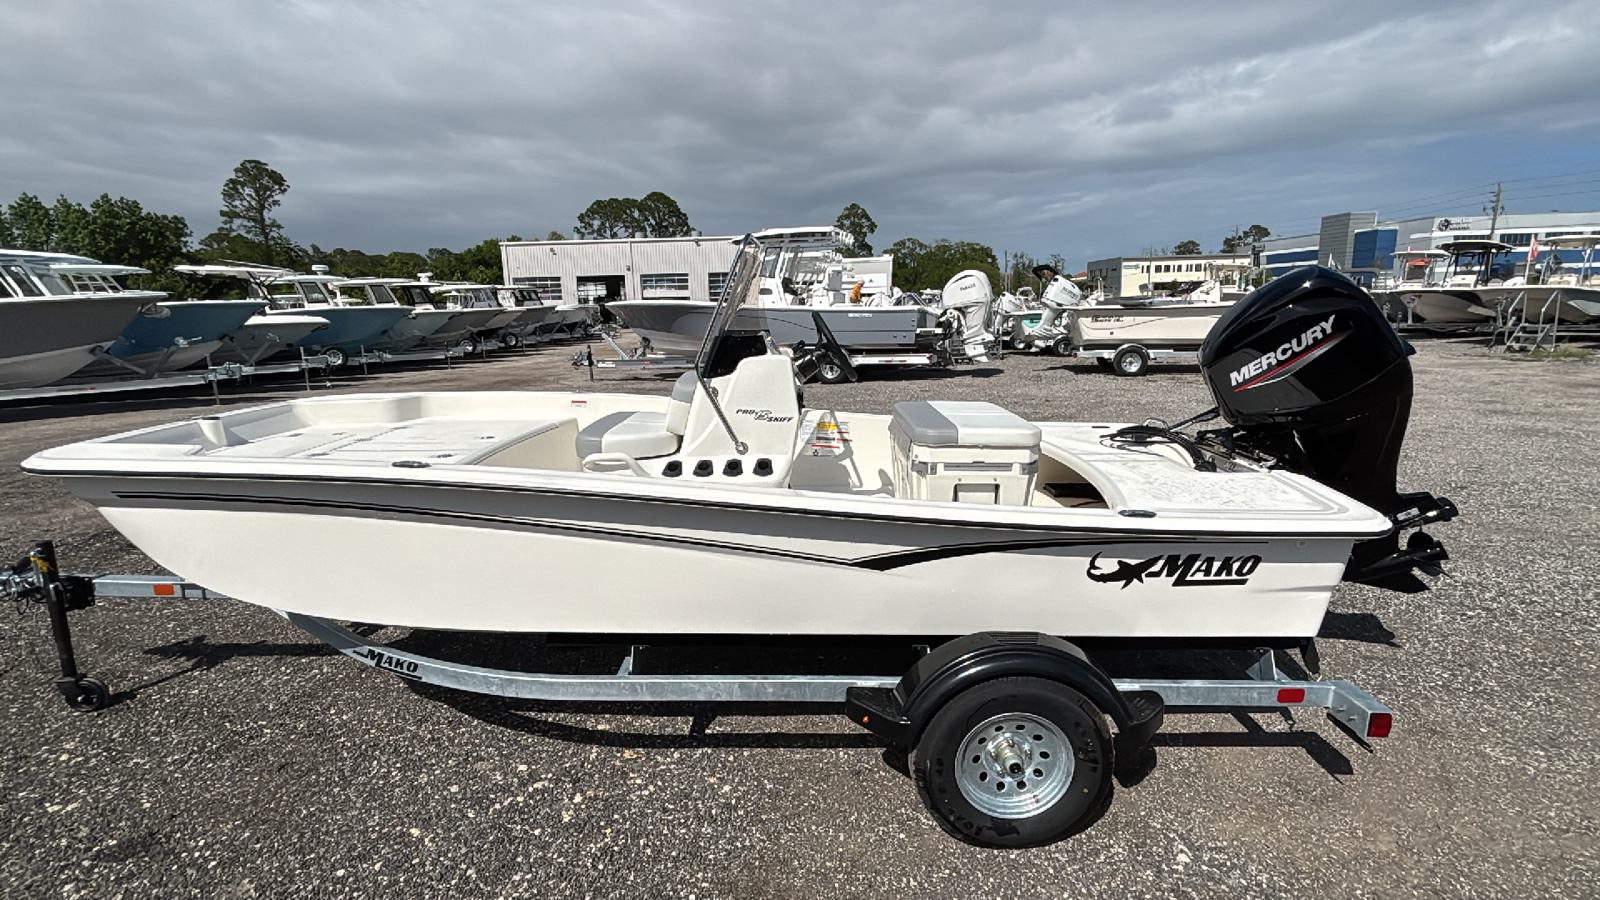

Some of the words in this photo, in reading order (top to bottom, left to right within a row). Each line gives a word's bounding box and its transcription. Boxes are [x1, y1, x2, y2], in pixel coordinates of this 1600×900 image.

[1229, 314, 1336, 387] MERCURY
[1145, 553, 1263, 587] MAKO
[353, 648, 423, 681] MAKO
